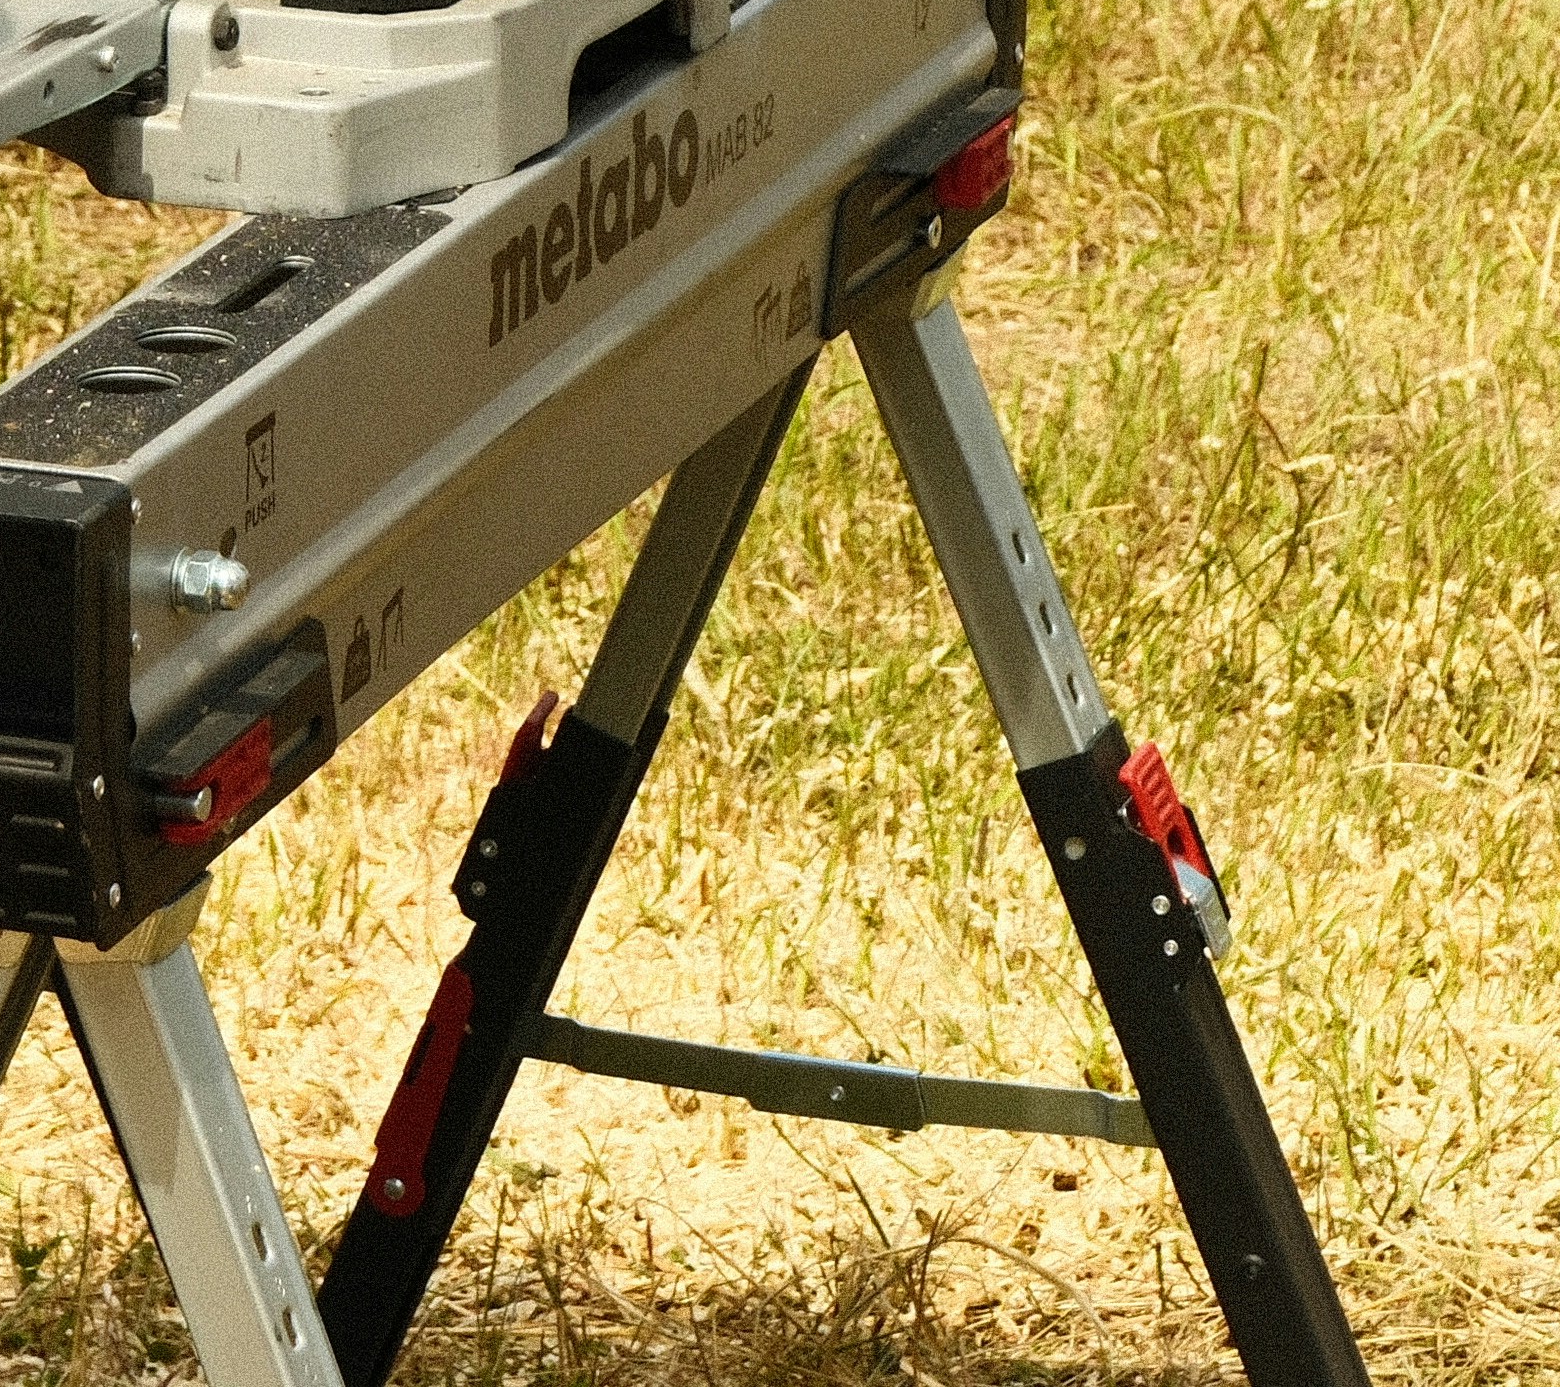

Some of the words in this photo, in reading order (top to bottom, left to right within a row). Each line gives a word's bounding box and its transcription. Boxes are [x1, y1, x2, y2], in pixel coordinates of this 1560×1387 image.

[487, 108, 701, 348] metabo
[705, 114, 748, 187] MAB
[752, 93, 776, 148] 82
[244, 492, 278, 534] PUSH
